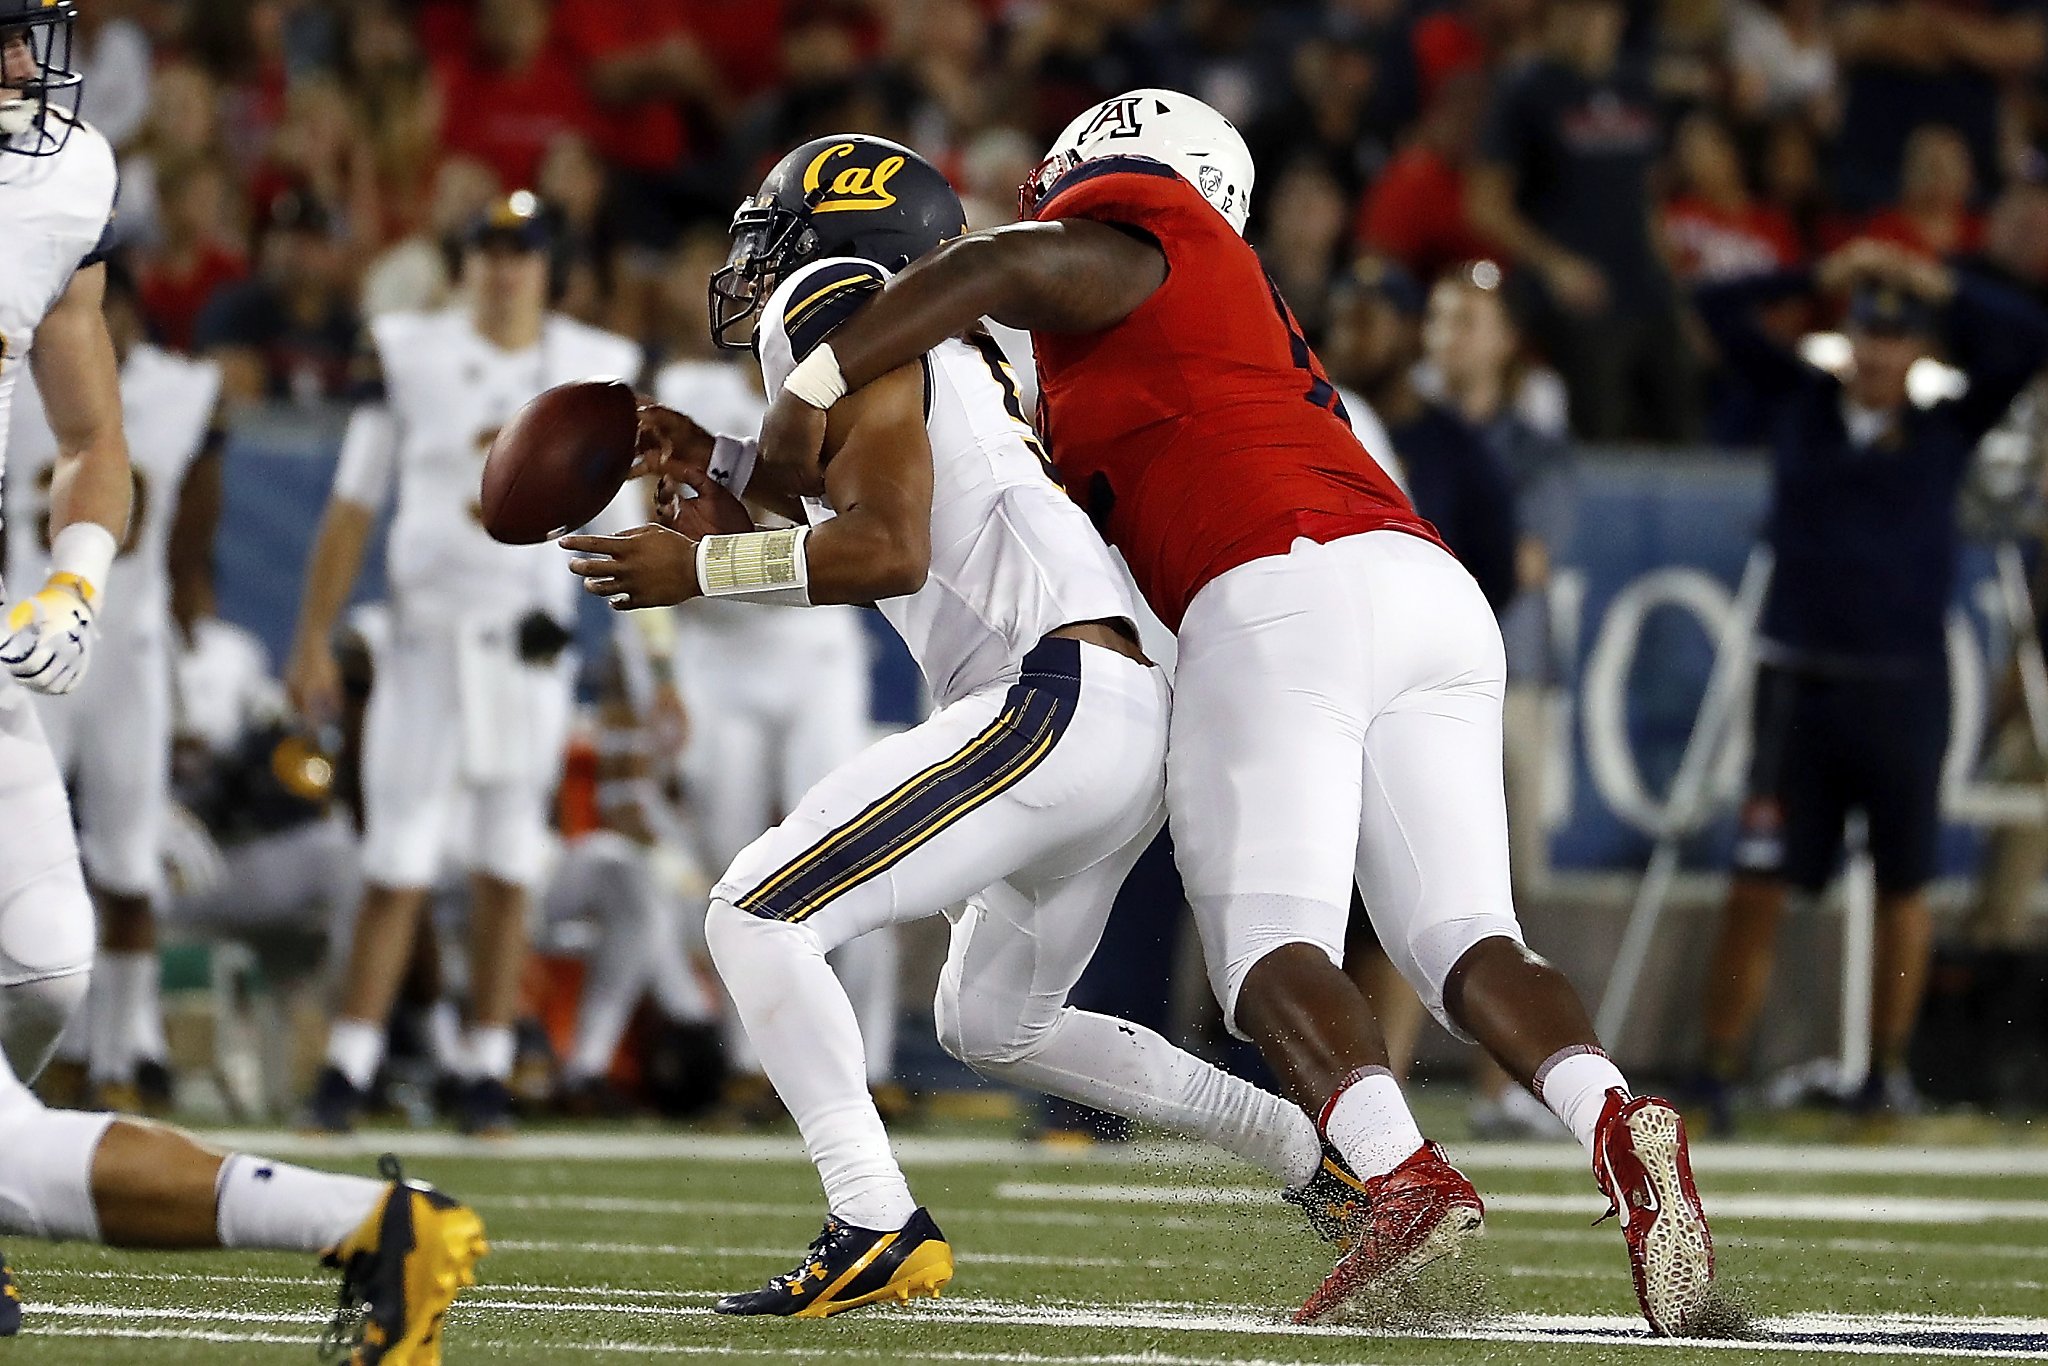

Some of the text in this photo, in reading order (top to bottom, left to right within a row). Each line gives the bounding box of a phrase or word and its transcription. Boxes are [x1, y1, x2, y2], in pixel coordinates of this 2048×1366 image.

[1077, 98, 1143, 146] A
[803, 143, 905, 214] Cal
[1204, 179, 1216, 192] 12
[1221, 196, 1233, 213] 12
